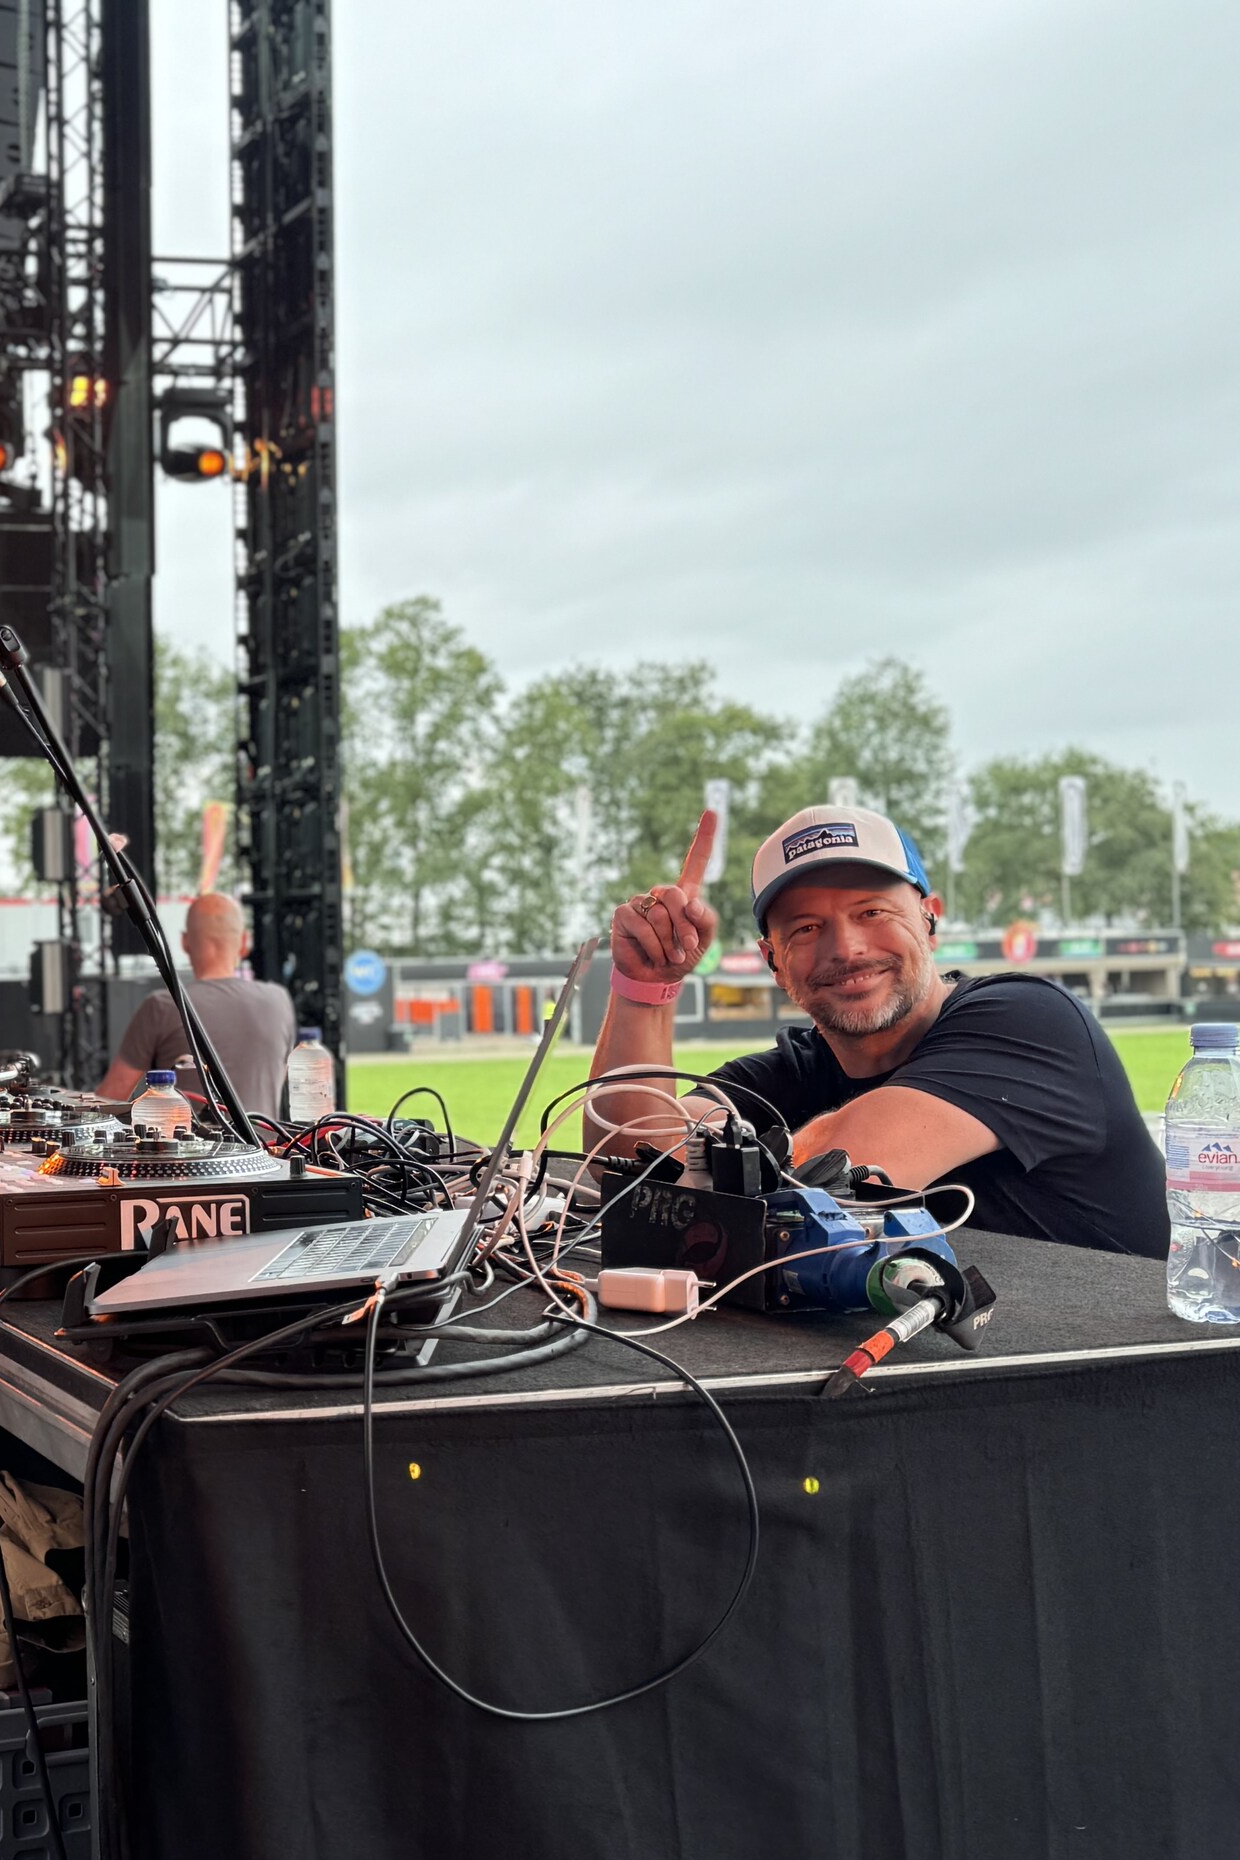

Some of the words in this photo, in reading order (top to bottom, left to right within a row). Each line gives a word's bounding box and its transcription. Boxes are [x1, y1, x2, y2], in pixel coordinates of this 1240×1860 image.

[788, 835, 854, 860] patagonia
[1197, 1152, 1238, 1164] evian
[120, 1196, 243, 1250] RANE
